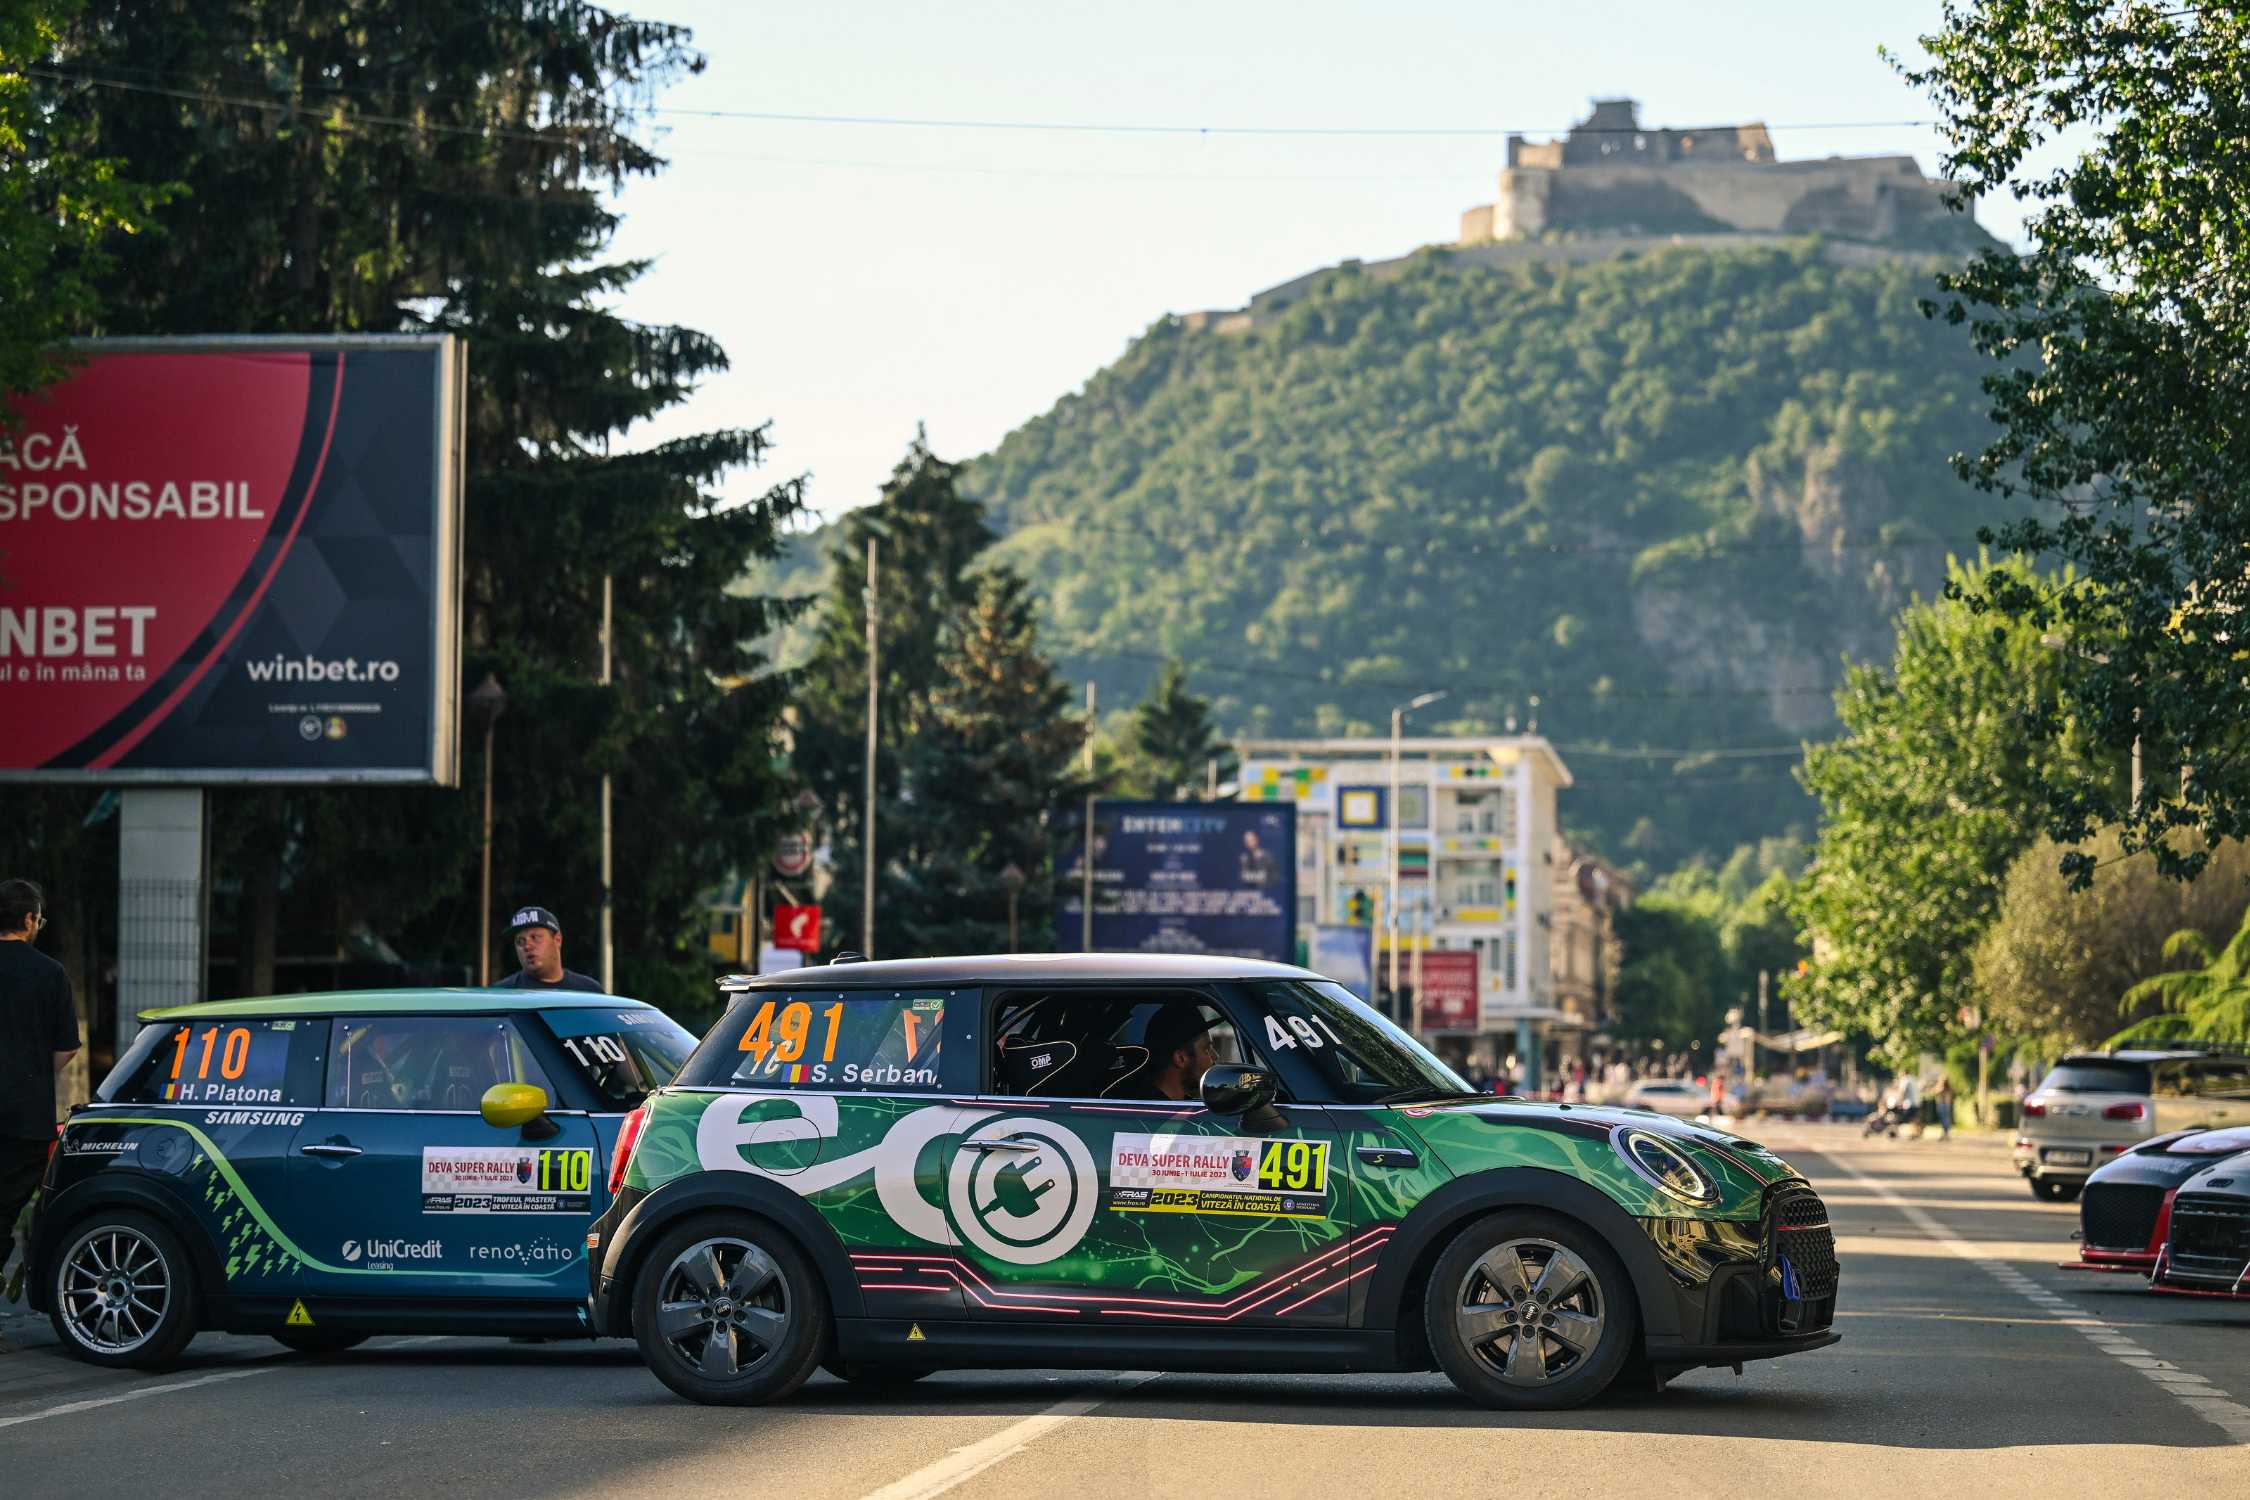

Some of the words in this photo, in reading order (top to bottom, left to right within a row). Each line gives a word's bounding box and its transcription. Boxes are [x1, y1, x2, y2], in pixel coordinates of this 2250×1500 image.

[0, 481, 265, 521] SPONSABIL
[0, 607, 156, 657] NBET
[18, 666, 30, 682] e
[62, 664, 119, 682] mâna
[126, 665, 146, 682] ta
[247, 654, 399, 682] winbet.ro
[738, 1001, 844, 1063] 491
[1264, 1015, 1343, 1051] 491
[171, 1027, 251, 1080] 110
[563, 1036, 626, 1067] 110
[1031, 1055, 1052, 1068] OMP
[811, 1064, 835, 1083] S.
[180, 1084, 198, 1100] H.
[205, 1084, 282, 1102] Platona
[205, 1111, 305, 1126] SAMSUNG
[81, 1142, 139, 1152] MICHELIN
[429, 1162, 452, 1173] DEVA
[455, 1162, 484, 1173] SUPER
[487, 1162, 515, 1173] RALLY
[1119, 1153, 1149, 1167] DEVA
[1152, 1153, 1190, 1168] SUPER
[1193, 1155, 1230, 1169] RALLY
[1259, 1142, 1327, 1190] 491
[539, 1151, 589, 1191] 110
[454, 1198, 491, 1209] 2023
[1151, 1192, 1198, 1207] 2023
[367, 1239, 443, 1258] UniCredit
[367, 1261, 394, 1270] Leasing
